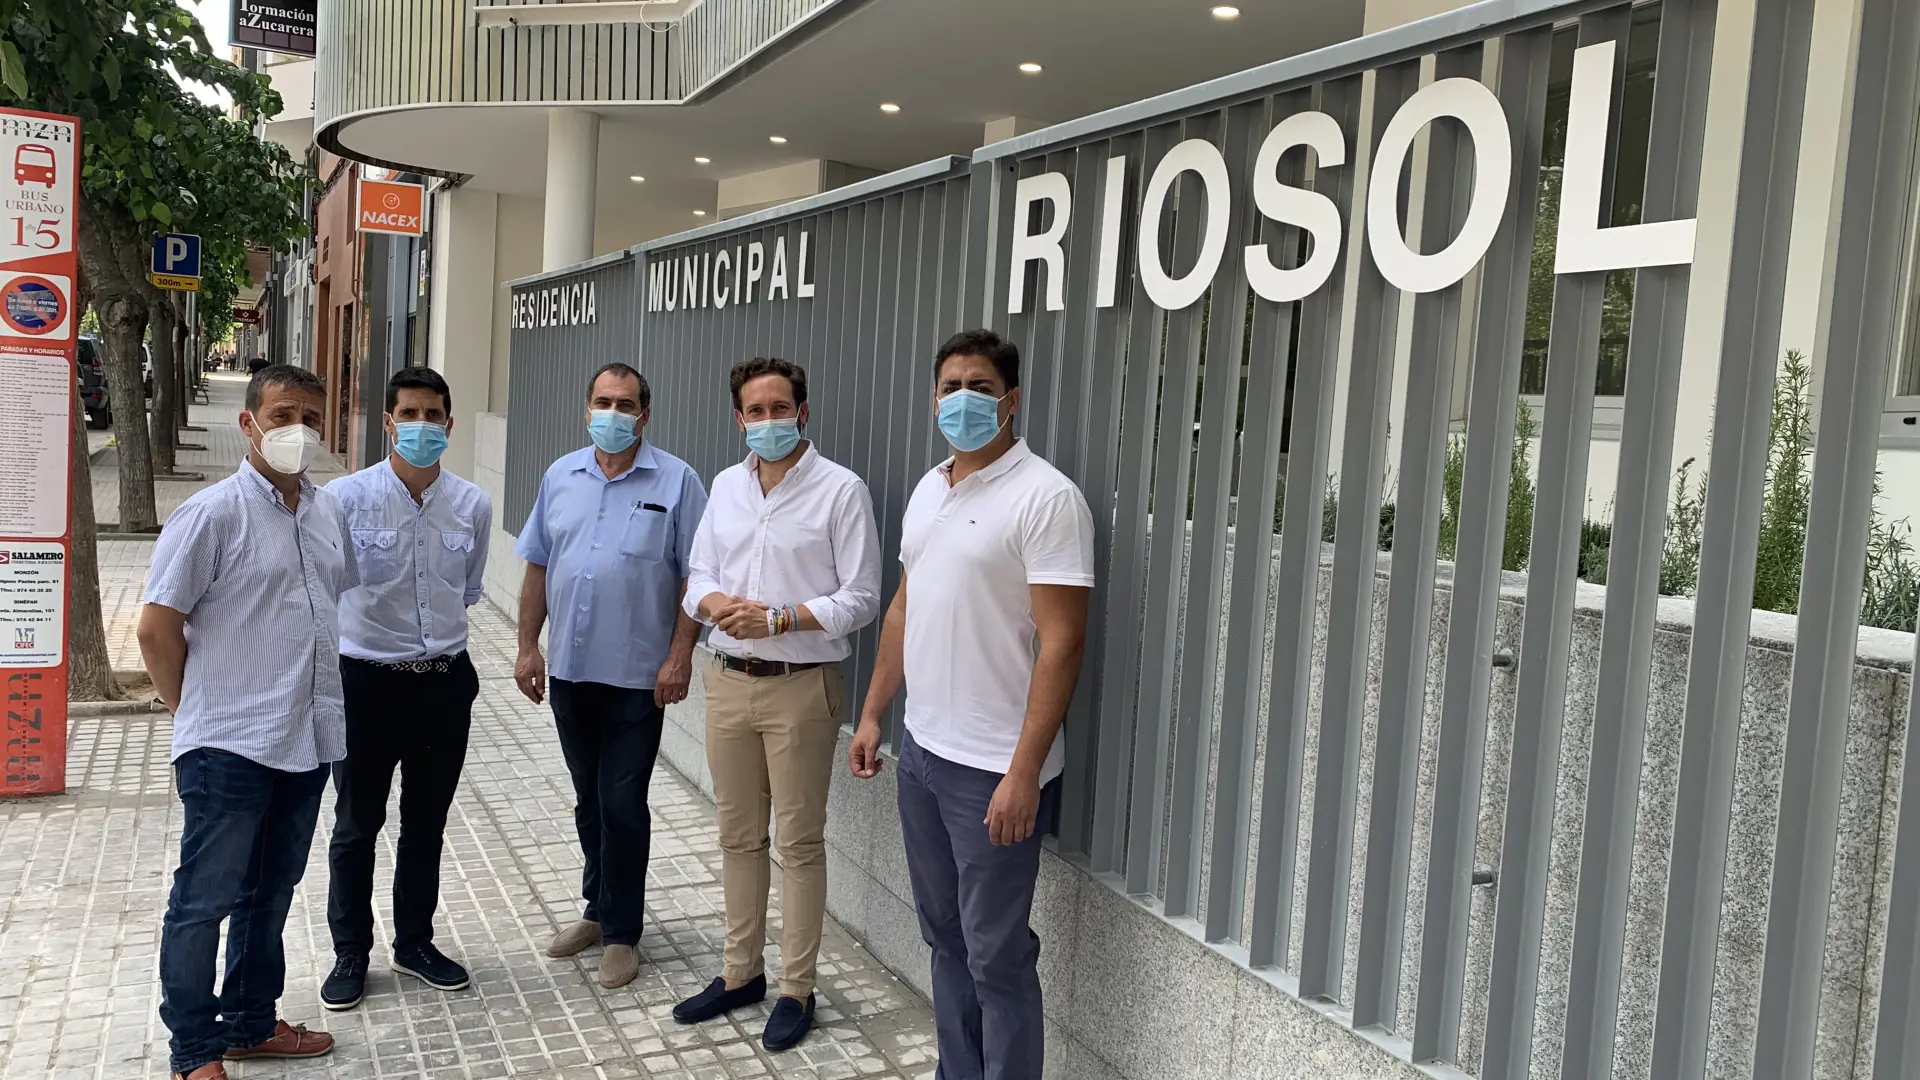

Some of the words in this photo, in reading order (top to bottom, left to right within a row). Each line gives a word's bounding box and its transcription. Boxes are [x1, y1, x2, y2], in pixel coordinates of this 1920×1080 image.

[512, 281, 596, 329] RESIDENCIA
[649, 231, 815, 312] MUNICIPAL
[1008, 40, 1697, 314] RIOSOL
[21, 190, 49, 201] BUS
[6, 200, 64, 214] URBANO
[362, 210, 419, 228] NACEX
[166, 237, 187, 270] P
[157, 278, 181, 286] 300m
[11, 552, 63, 560] SALAMERO
